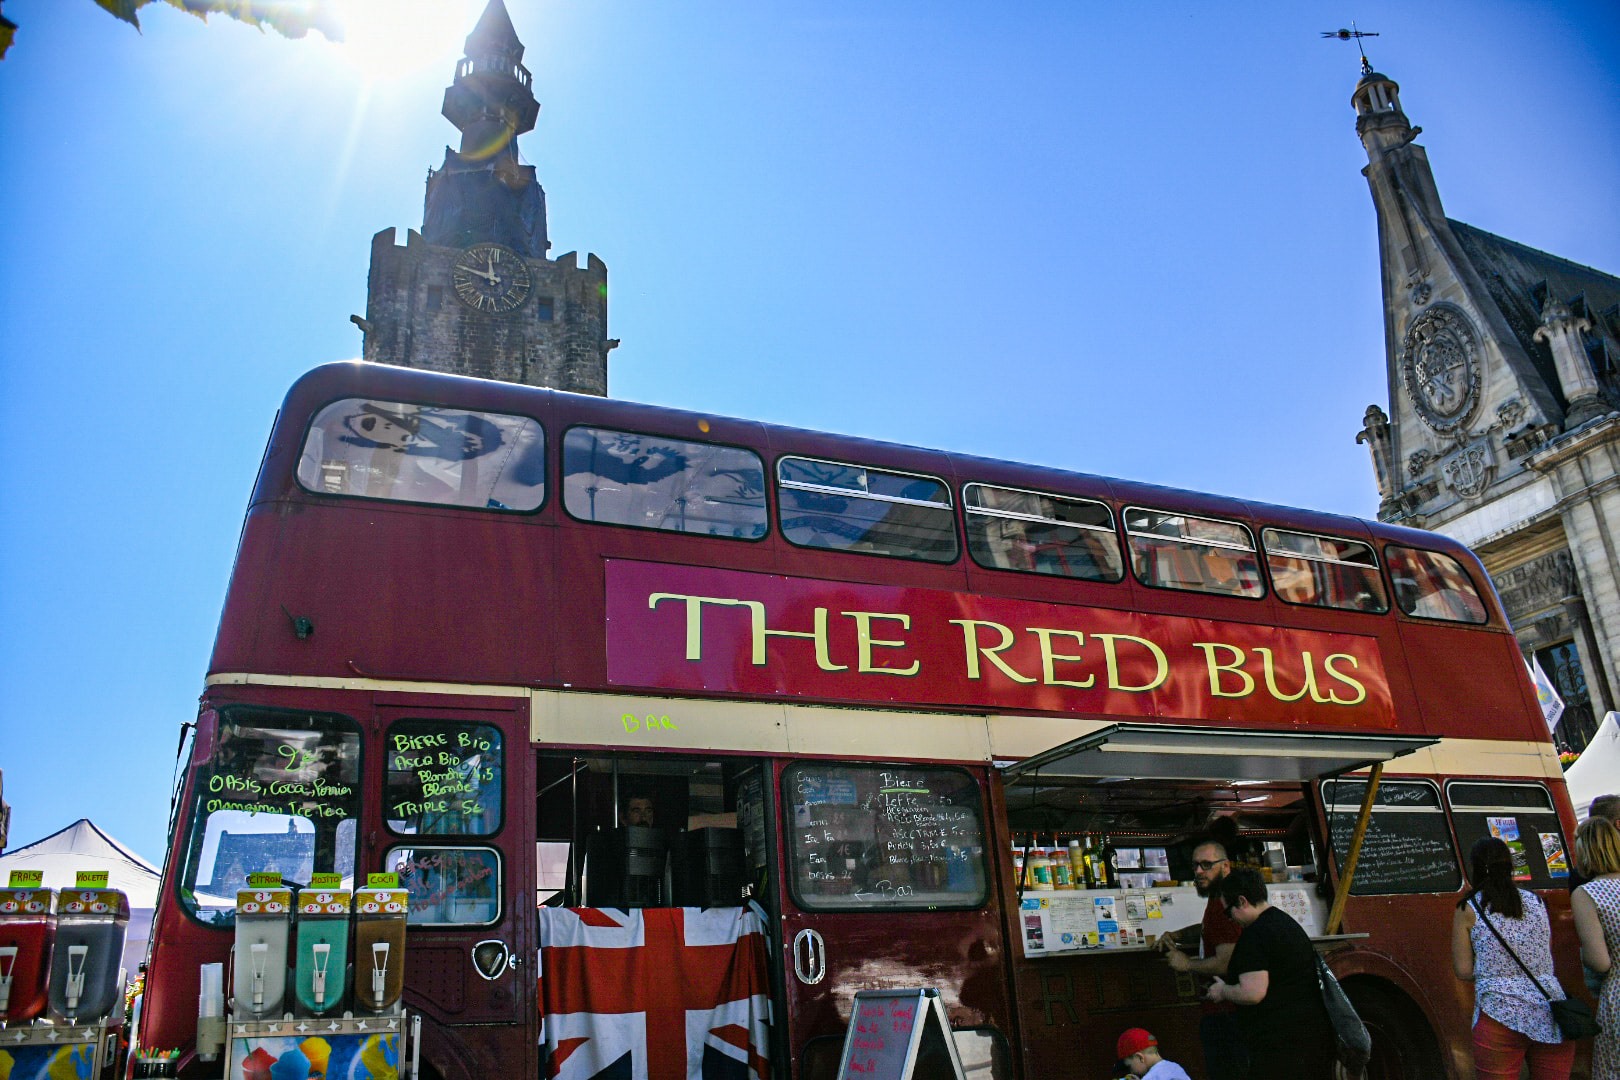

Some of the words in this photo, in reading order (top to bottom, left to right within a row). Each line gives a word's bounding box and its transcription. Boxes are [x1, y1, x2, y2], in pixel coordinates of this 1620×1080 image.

[649, 592, 920, 676] THE
[948, 619, 1169, 692] RED
[1193, 642, 1367, 705] BUS
[621, 713, 679, 733] BAR
[315, 803, 347, 818] Tea
[393, 800, 448, 817] TRIPLE
[370, 876, 394, 884] COCA
